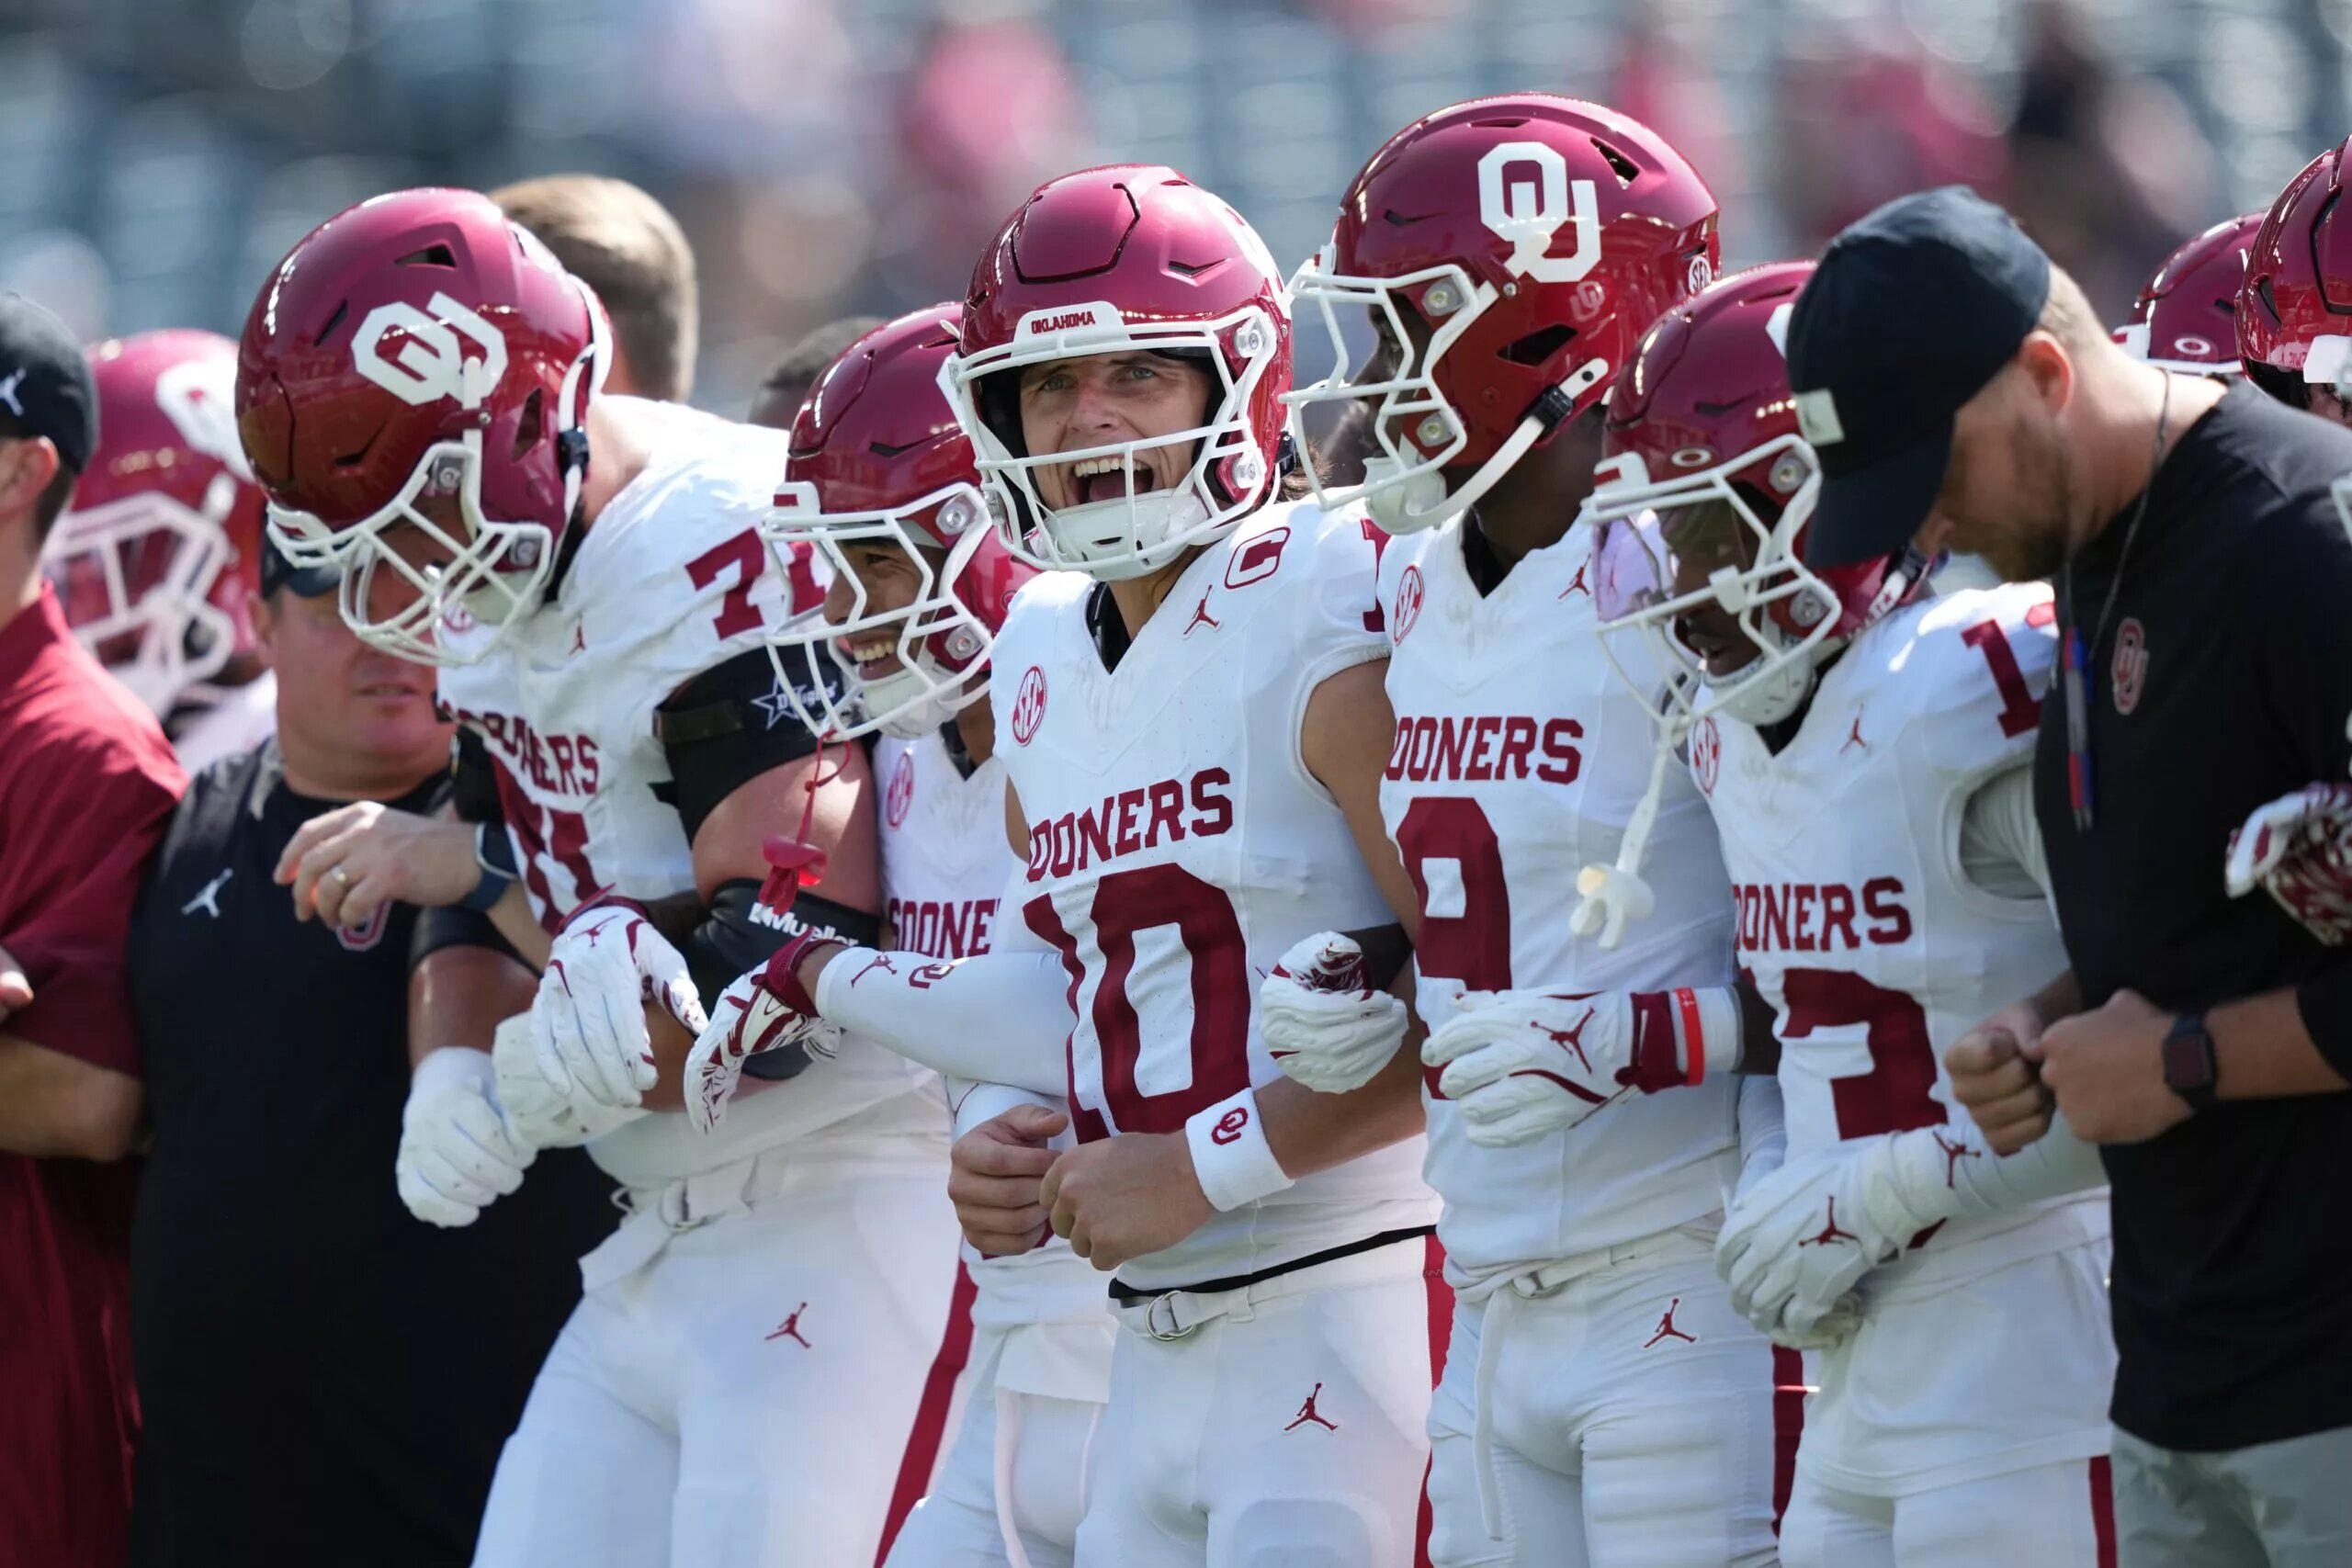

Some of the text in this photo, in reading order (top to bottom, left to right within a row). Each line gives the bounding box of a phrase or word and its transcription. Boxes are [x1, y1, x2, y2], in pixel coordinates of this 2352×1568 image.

[1478, 141, 1601, 283] OU
[352, 291, 508, 405] OU
[1031, 310, 1096, 334] OKLAHOMA
[684, 526, 828, 641] 71
[1225, 526, 1291, 589] C
[1385, 716, 1584, 785] OONERS
[1026, 766, 1233, 883] OONERS
[888, 897, 1001, 959] SOONE
[1022, 862, 1251, 1145] 10
[1211, 1107, 1249, 1145] OU
